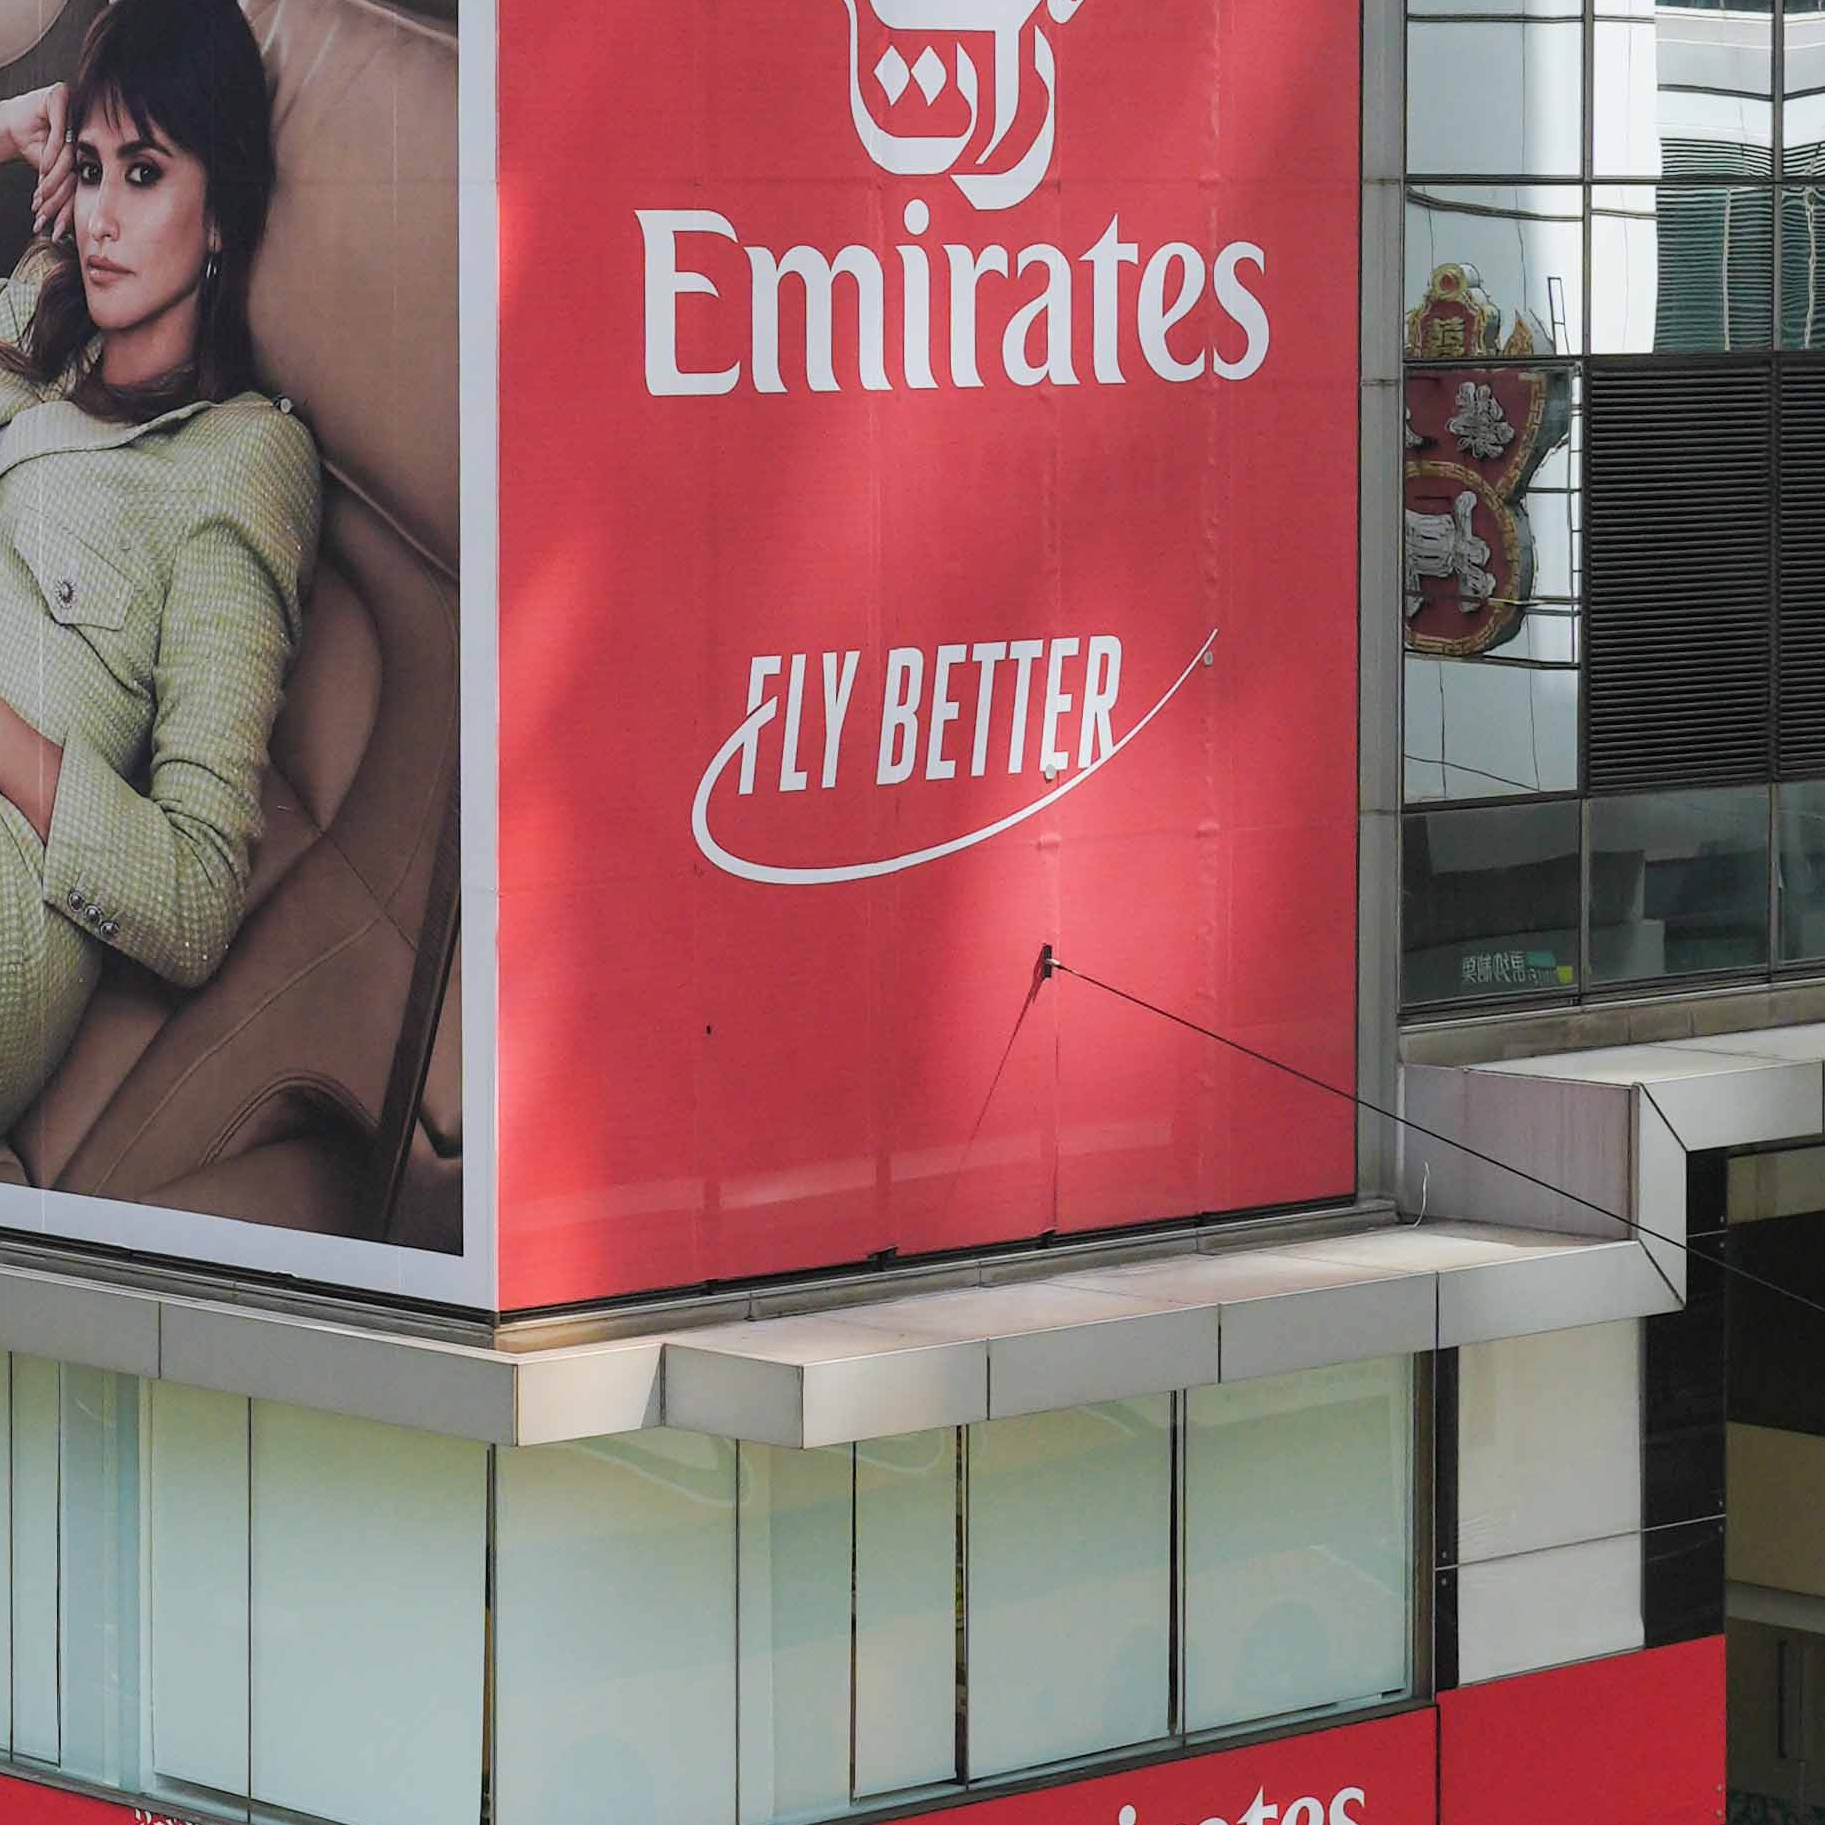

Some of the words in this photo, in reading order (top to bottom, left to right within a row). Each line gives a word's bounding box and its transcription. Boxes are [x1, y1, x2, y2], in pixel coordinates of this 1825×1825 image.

[635, 199, 1270, 396] Emirates
[736, 650, 861, 795] FLY
[876, 634, 1123, 786] BETTER
